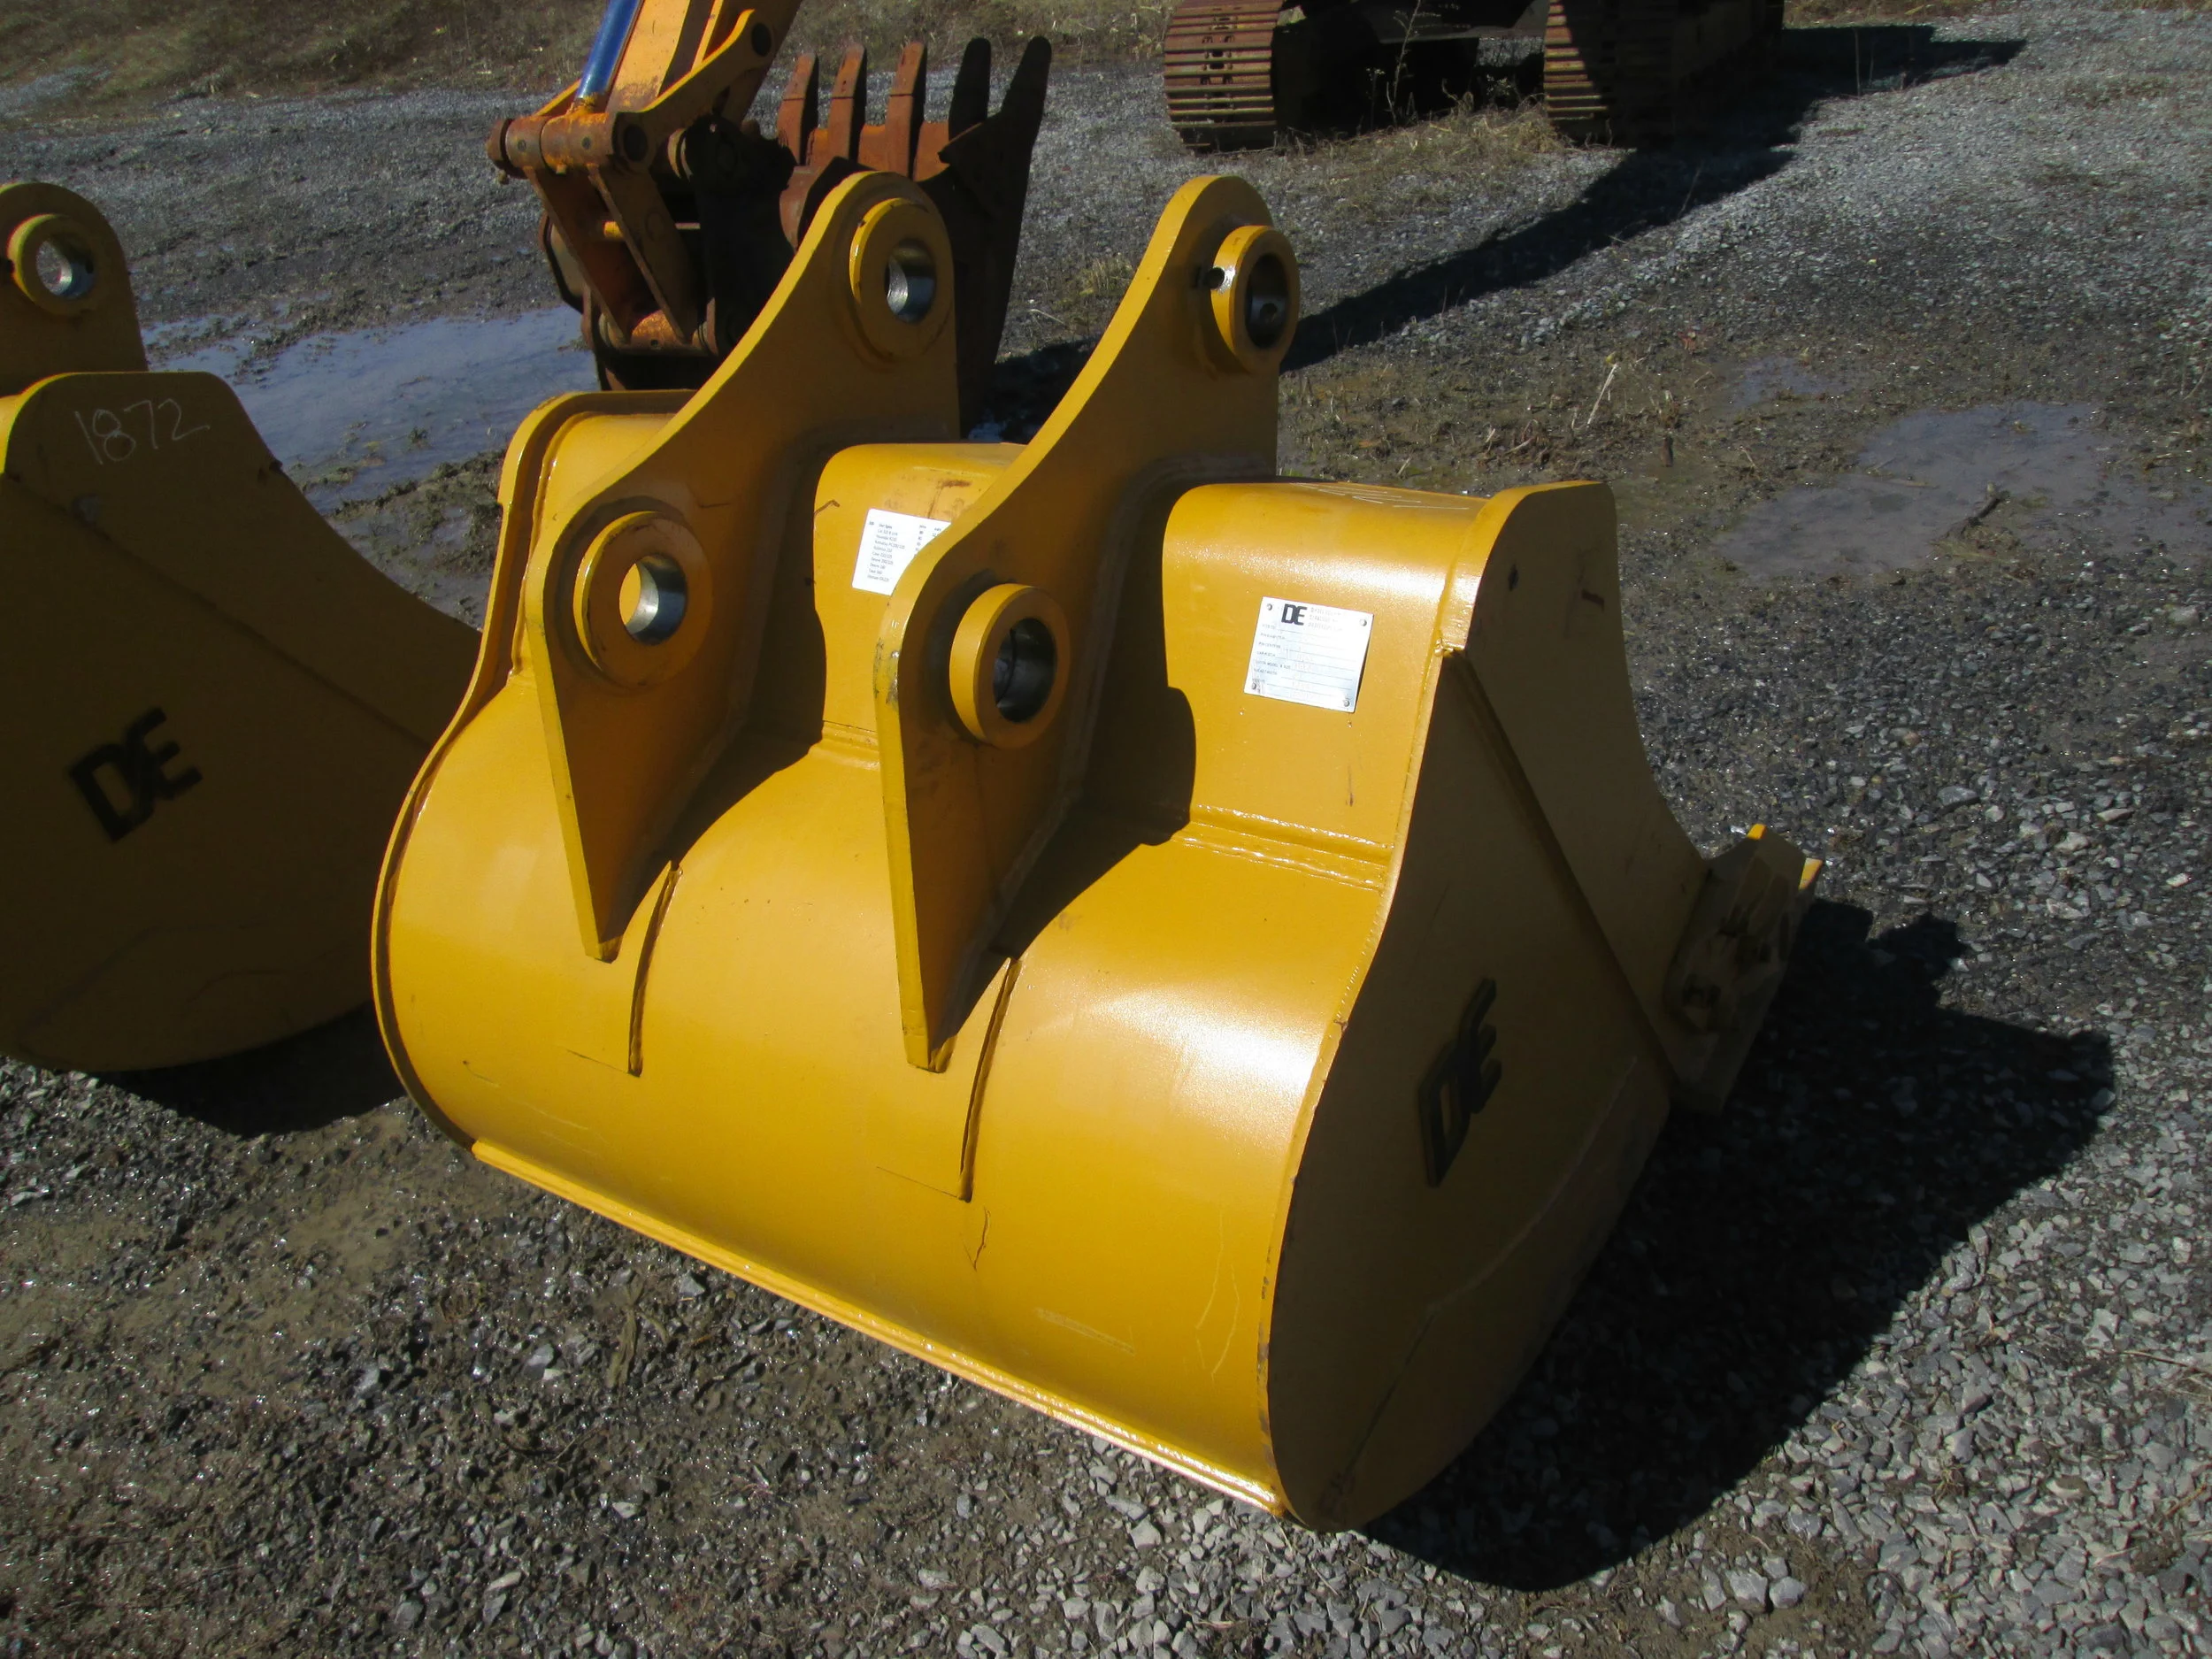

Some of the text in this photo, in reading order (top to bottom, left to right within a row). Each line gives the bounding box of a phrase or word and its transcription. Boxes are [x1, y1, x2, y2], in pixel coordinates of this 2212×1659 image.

[74, 398, 210, 465] 1872
[1281, 603, 1308, 626] DE
[68, 706, 203, 842] DE
[1417, 977, 1502, 1187] DE
